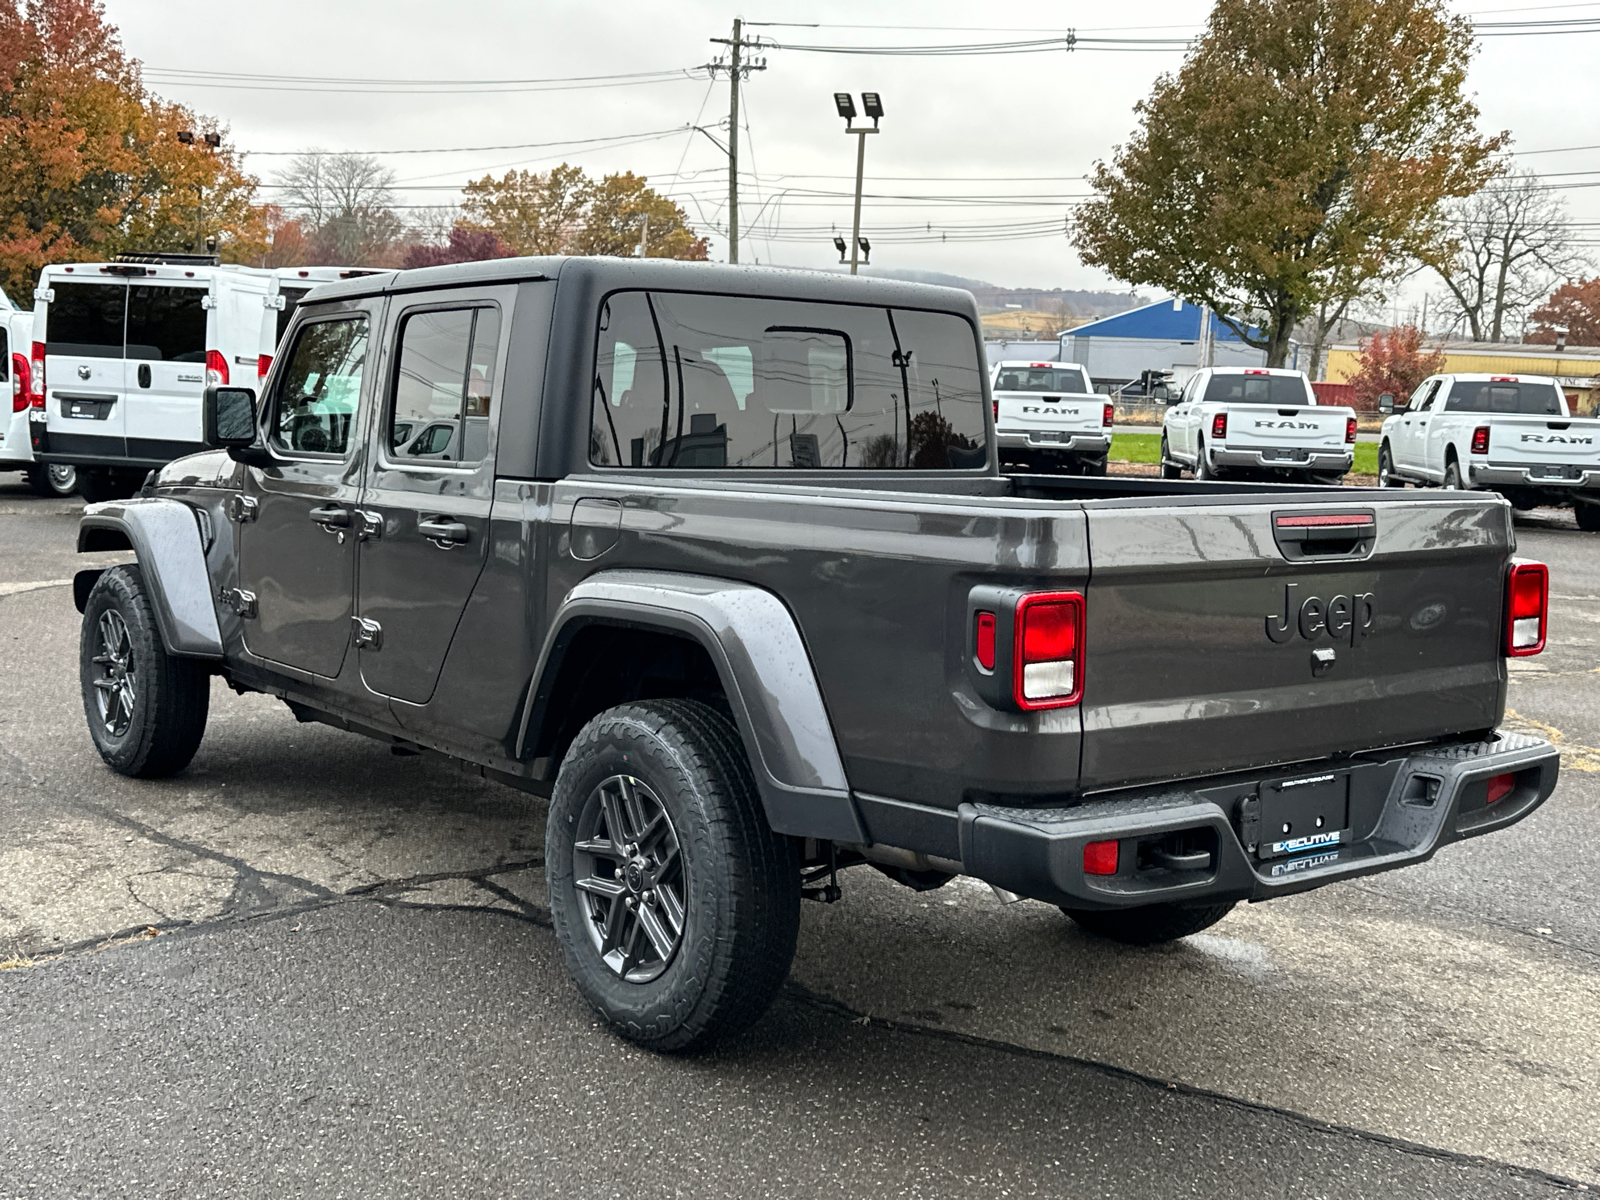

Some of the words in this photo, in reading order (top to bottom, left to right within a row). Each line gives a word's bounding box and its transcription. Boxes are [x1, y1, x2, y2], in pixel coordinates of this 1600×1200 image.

[1023, 406, 1079, 415] RAM
[1255, 420, 1319, 430] RAM
[1521, 434, 1593, 445] RAM
[1265, 583, 1375, 648] Jeep
[1272, 831, 1340, 853] EXECUTIVE
